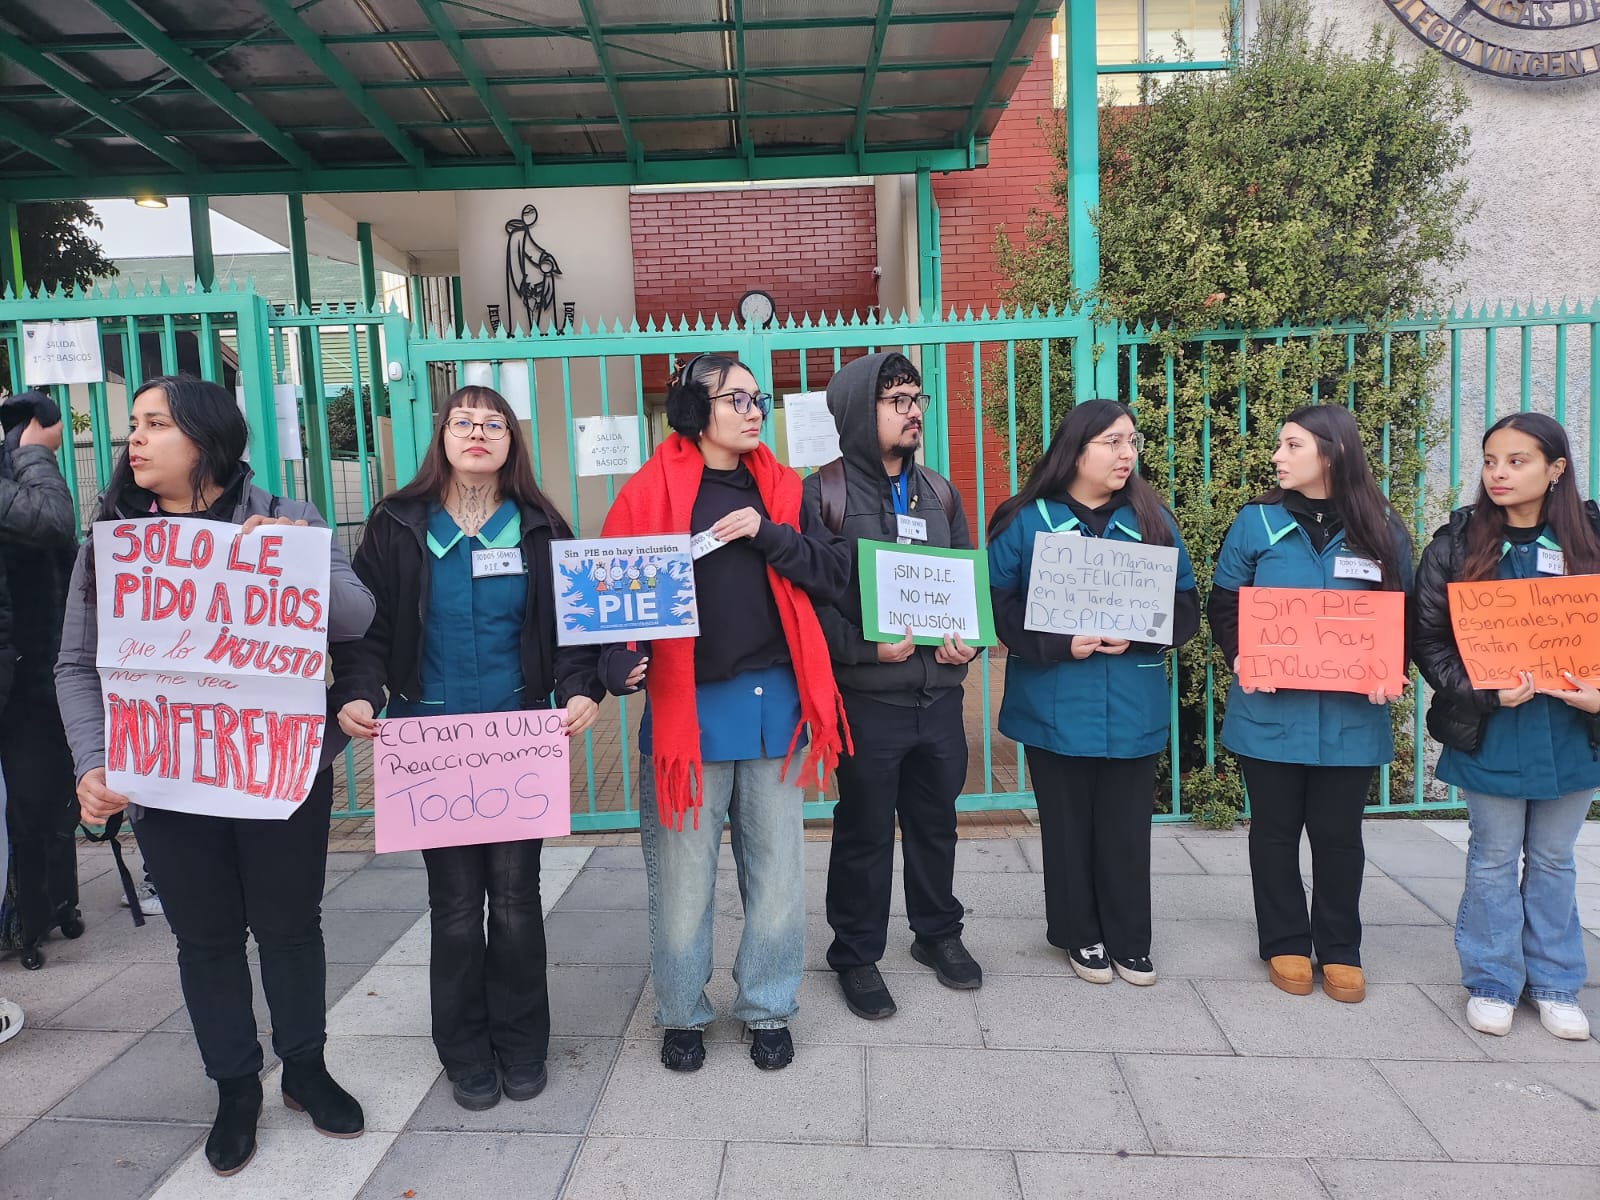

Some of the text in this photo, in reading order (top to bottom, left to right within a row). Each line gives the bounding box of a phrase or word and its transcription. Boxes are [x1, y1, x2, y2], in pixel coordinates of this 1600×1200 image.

[1481, 42, 1585, 76] VIRGEN
[47, 340, 76, 349] SALIDA
[596, 433, 623, 442] SALIDA
[112, 518, 283, 577] SÓLO LE
[564, 550, 579, 559] Sin
[584, 548, 600, 558] PIE
[616, 547, 633, 558] hay
[635, 544, 678, 554] inclusión
[1040, 535, 1072, 564] En
[894, 564, 920, 581] ¡SIN
[1038, 569, 1077, 585] nos
[206, 582, 233, 624] A
[598, 591, 659, 624] PIE
[900, 589, 952, 606] NO HAY
[1034, 586, 1159, 611] en la Tarde nos
[1250, 588, 1375, 620] Sin PIE
[1458, 583, 1599, 613] NOS llaman
[888, 611, 966, 631] INCLUSIÓN!
[1030, 602, 1168, 638] DESPIDEN!
[1565, 611, 1599, 624] no
[118, 637, 157, 666] que
[162, 629, 195, 659] lo
[1260, 622, 1375, 650] NO hay
[1460, 634, 1518, 654] Tratan
[156, 673, 186, 685] me
[197, 675, 238, 690] sea
[1464, 656, 1600, 682] Descrtables
[485, 721, 499, 738] a
[380, 744, 563, 775] Reaccionamos
